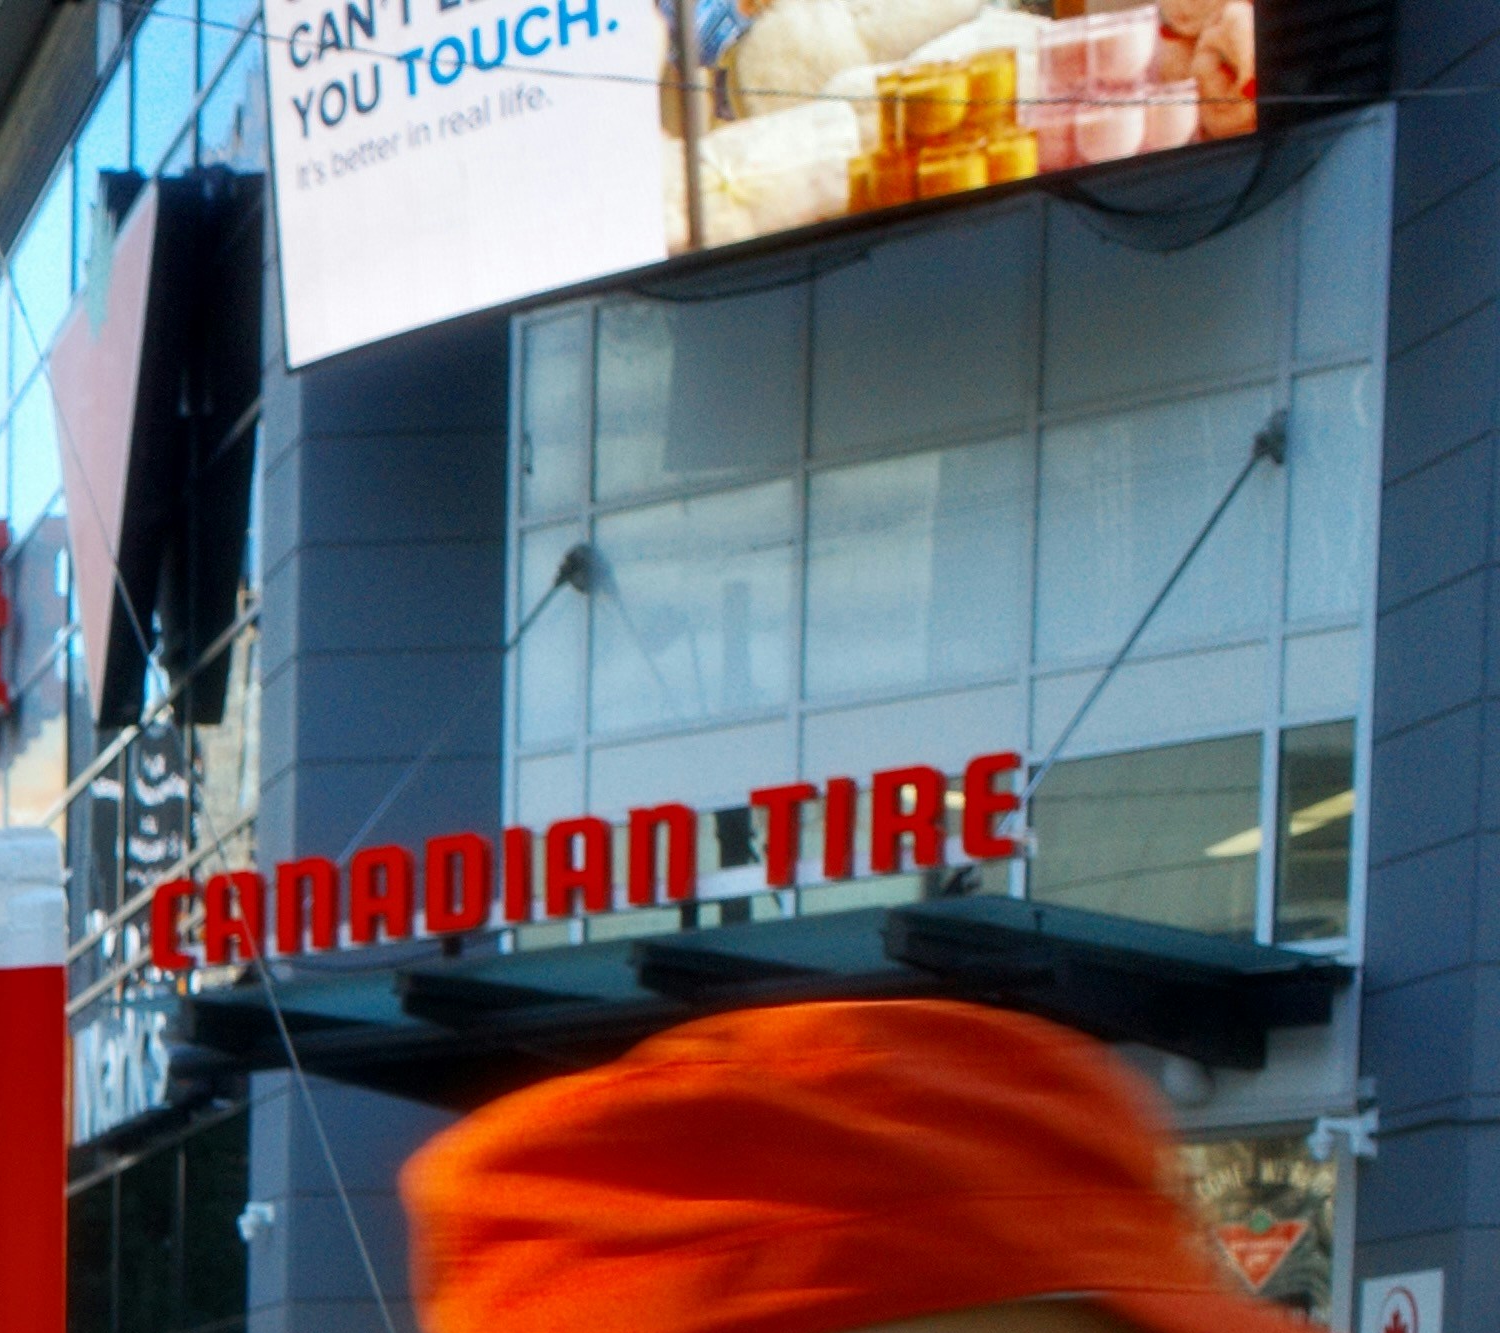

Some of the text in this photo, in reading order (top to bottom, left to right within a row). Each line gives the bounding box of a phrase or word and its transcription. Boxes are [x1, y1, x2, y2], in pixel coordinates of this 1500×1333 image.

[292, 0, 620, 139] YOU TOUCH.
[330, 130, 400, 179] better
[406, 118, 434, 150] in
[438, 98, 492, 139] real
[498, 80, 554, 123] life.
[150, 802, 698, 972] CANADIAN
[749, 752, 1025, 890] TIRE
